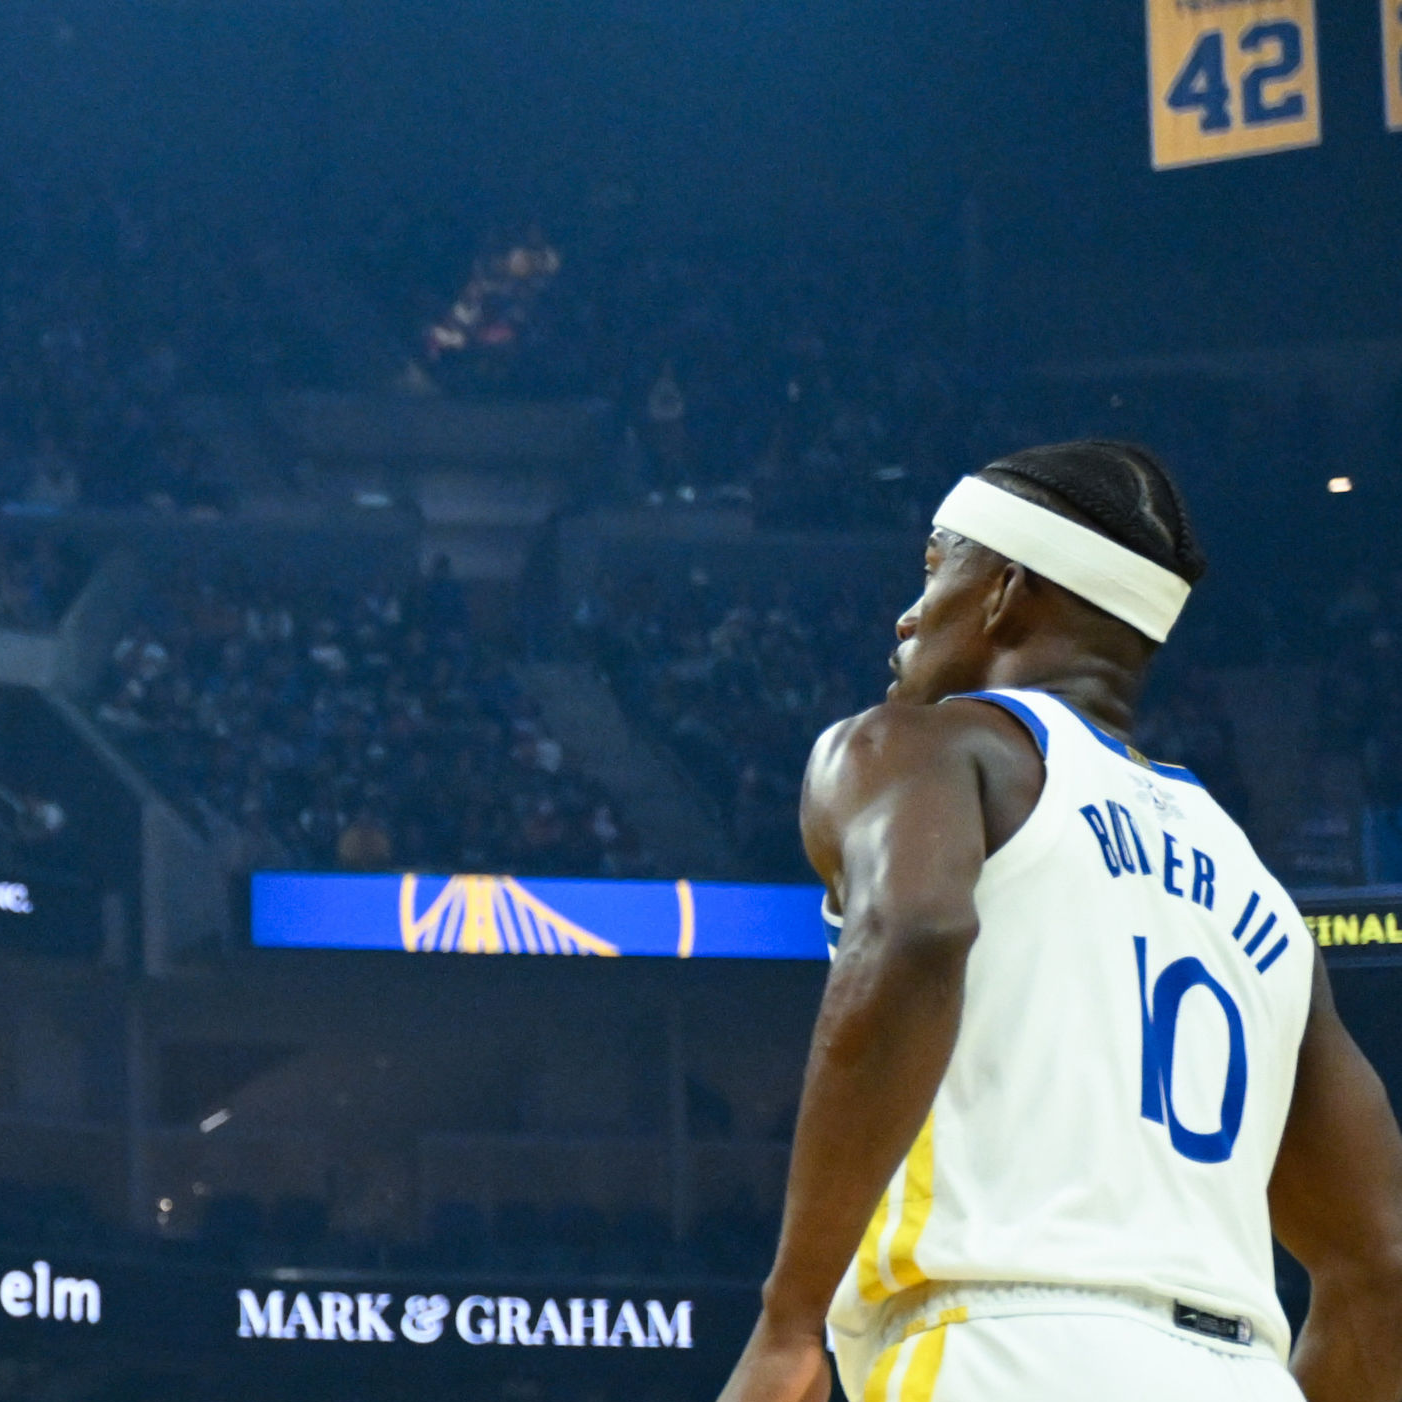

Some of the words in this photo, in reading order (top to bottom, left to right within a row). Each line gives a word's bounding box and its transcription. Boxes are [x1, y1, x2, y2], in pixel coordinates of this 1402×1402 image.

[1166, 19, 1306, 132] 42
[1078, 799, 1215, 911] BUTER
[1132, 935, 1248, 1165] 10
[0, 1260, 101, 1324] elm
[236, 1288, 396, 1342] MARK
[400, 1293, 451, 1344] &
[455, 1294, 694, 1348] GRAHAM
